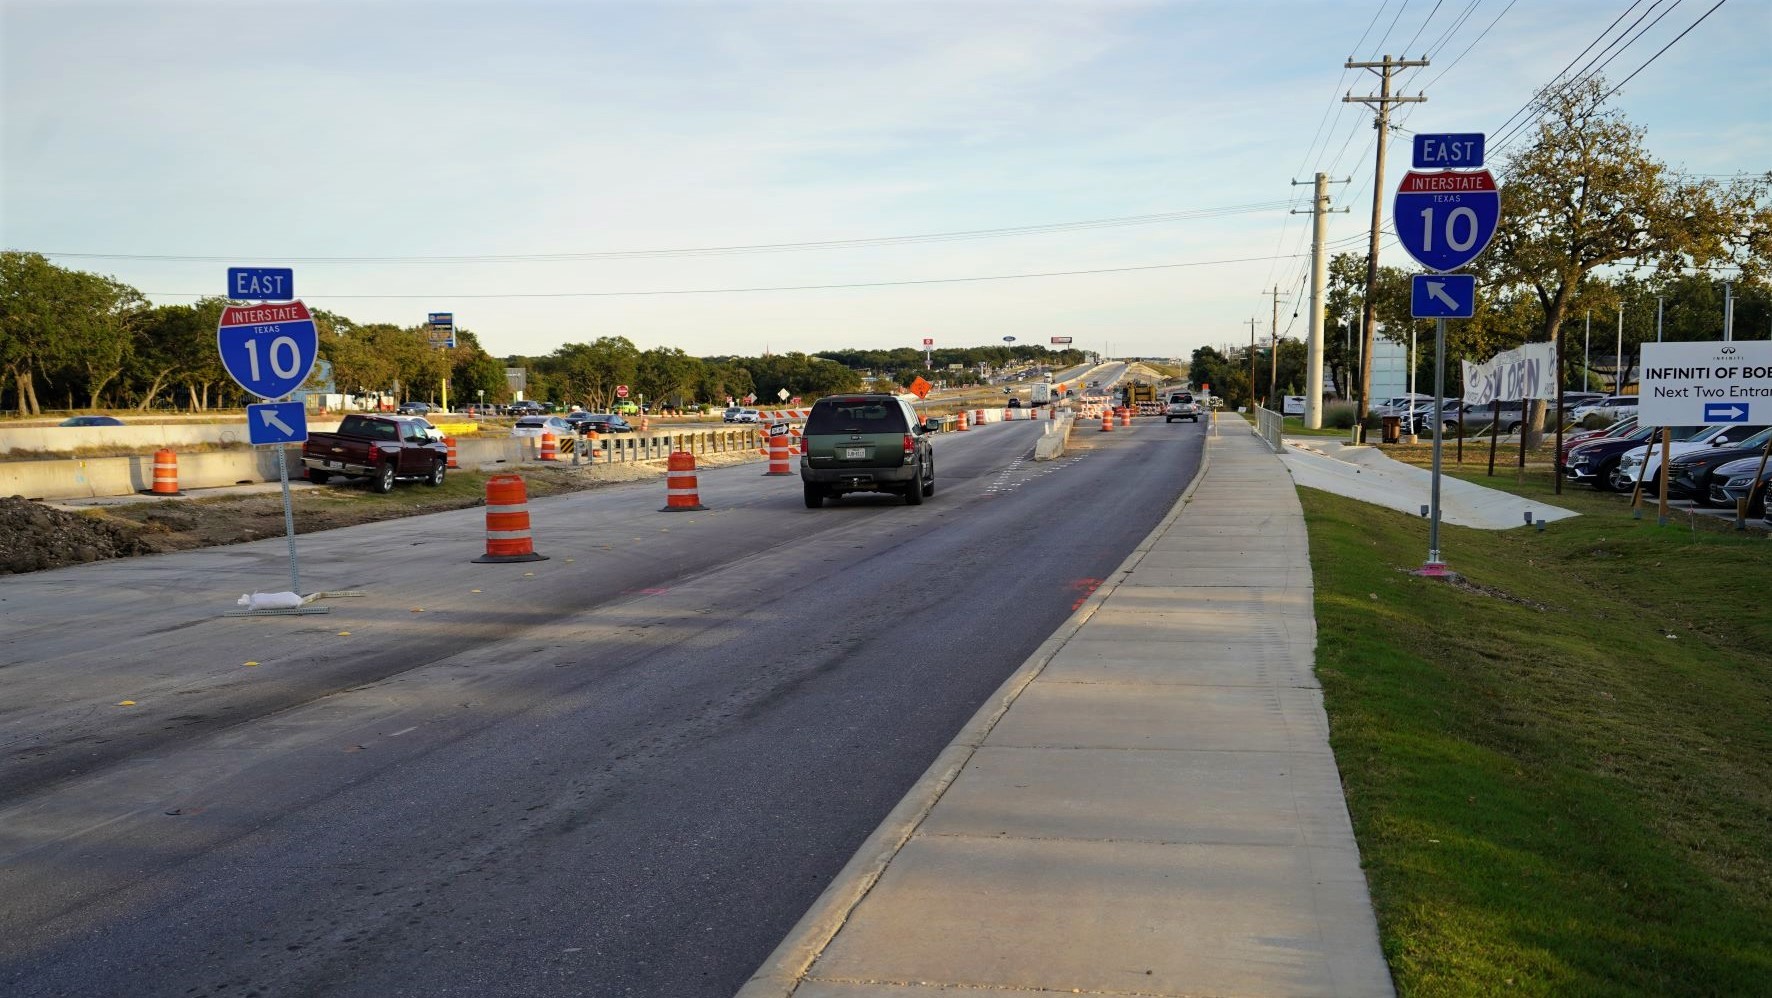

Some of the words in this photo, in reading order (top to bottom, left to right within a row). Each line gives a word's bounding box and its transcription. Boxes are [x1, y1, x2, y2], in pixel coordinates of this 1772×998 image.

[1423, 139, 1474, 162] EAST
[1412, 176, 1484, 190] INTERSTATE
[1433, 194, 1461, 203] TEXAS
[1421, 206, 1479, 252] 10
[236, 272, 284, 294] EAST
[232, 307, 299, 324] INTERSTATE
[253, 325, 281, 334] TEXAS
[244, 335, 301, 382] 10
[1645, 367, 1710, 380] INFINITI
[1714, 366, 1739, 379] OF
[1654, 385, 1689, 398] Next
[1693, 385, 1725, 398] Two
